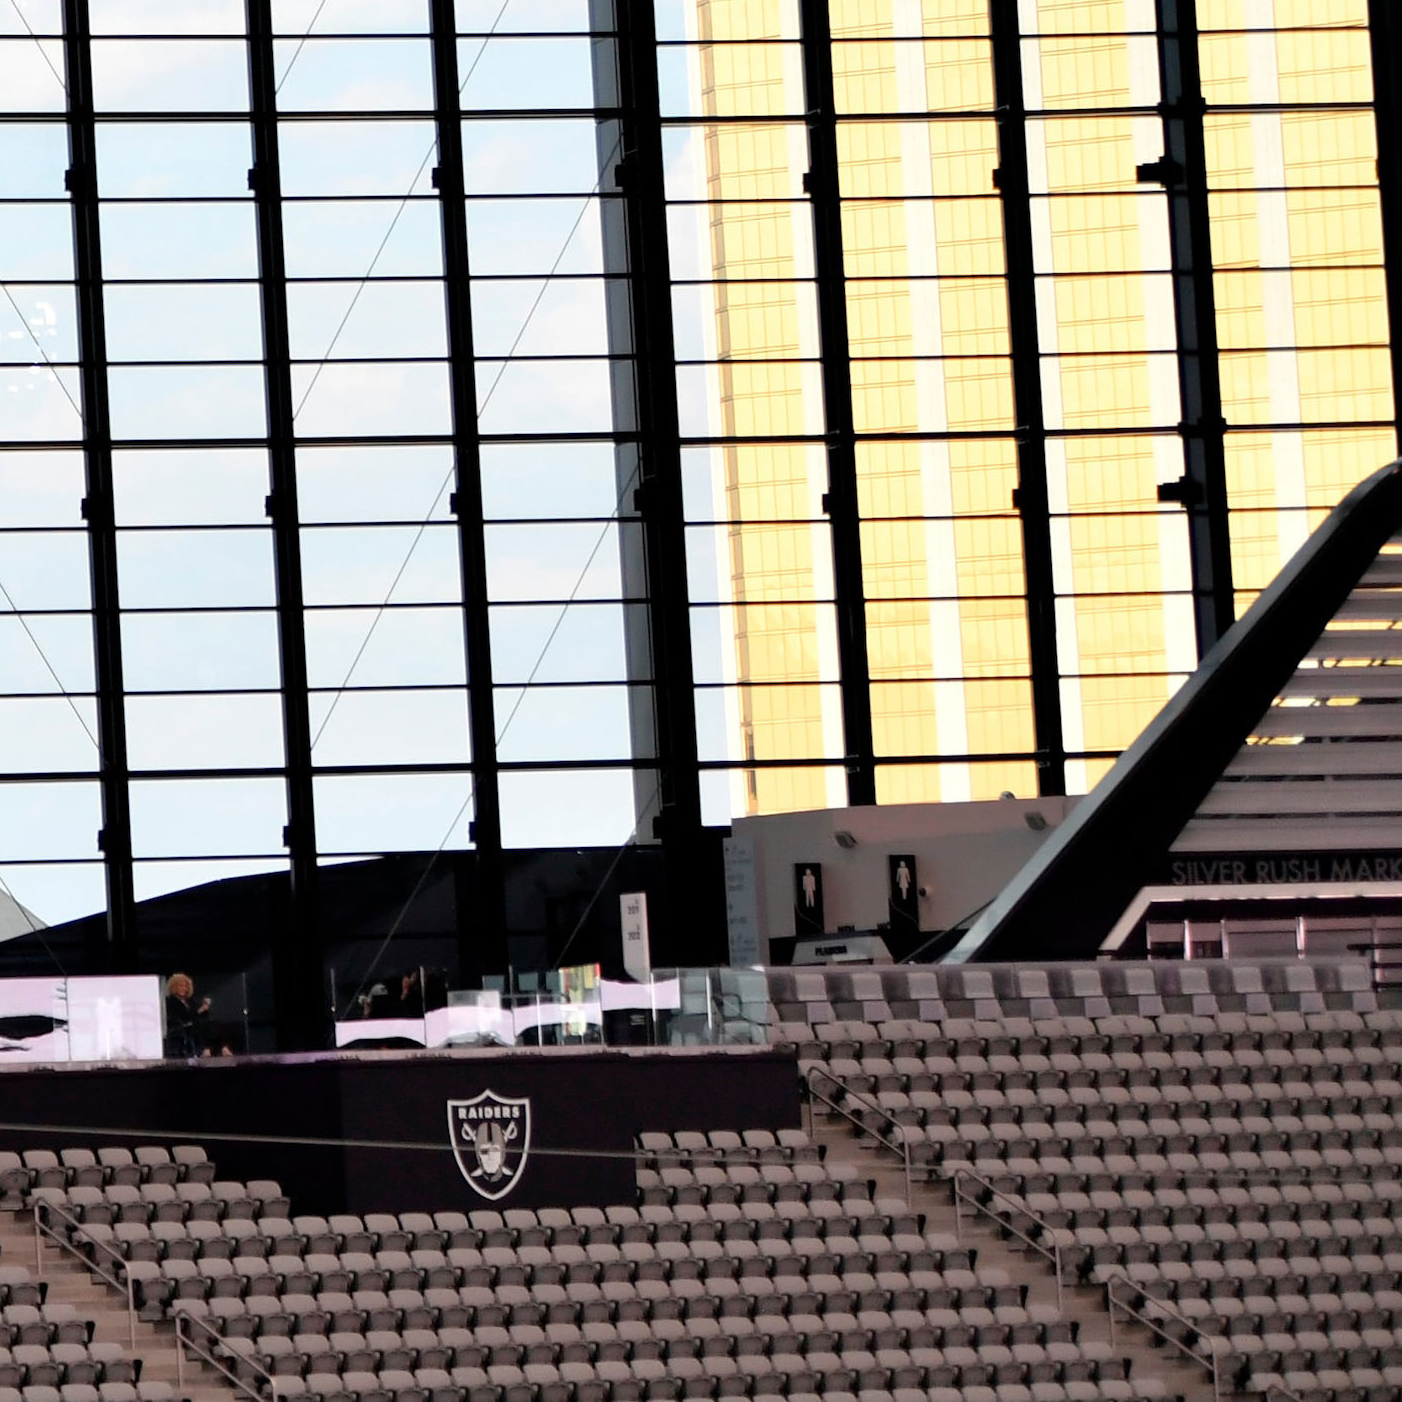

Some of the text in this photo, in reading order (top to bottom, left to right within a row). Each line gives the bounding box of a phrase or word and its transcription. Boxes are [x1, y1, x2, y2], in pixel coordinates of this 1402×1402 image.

[1170, 860, 1246, 887] SILVER
[1255, 858, 1321, 884] RUSH
[458, 1105, 521, 1120] RAIDERS
